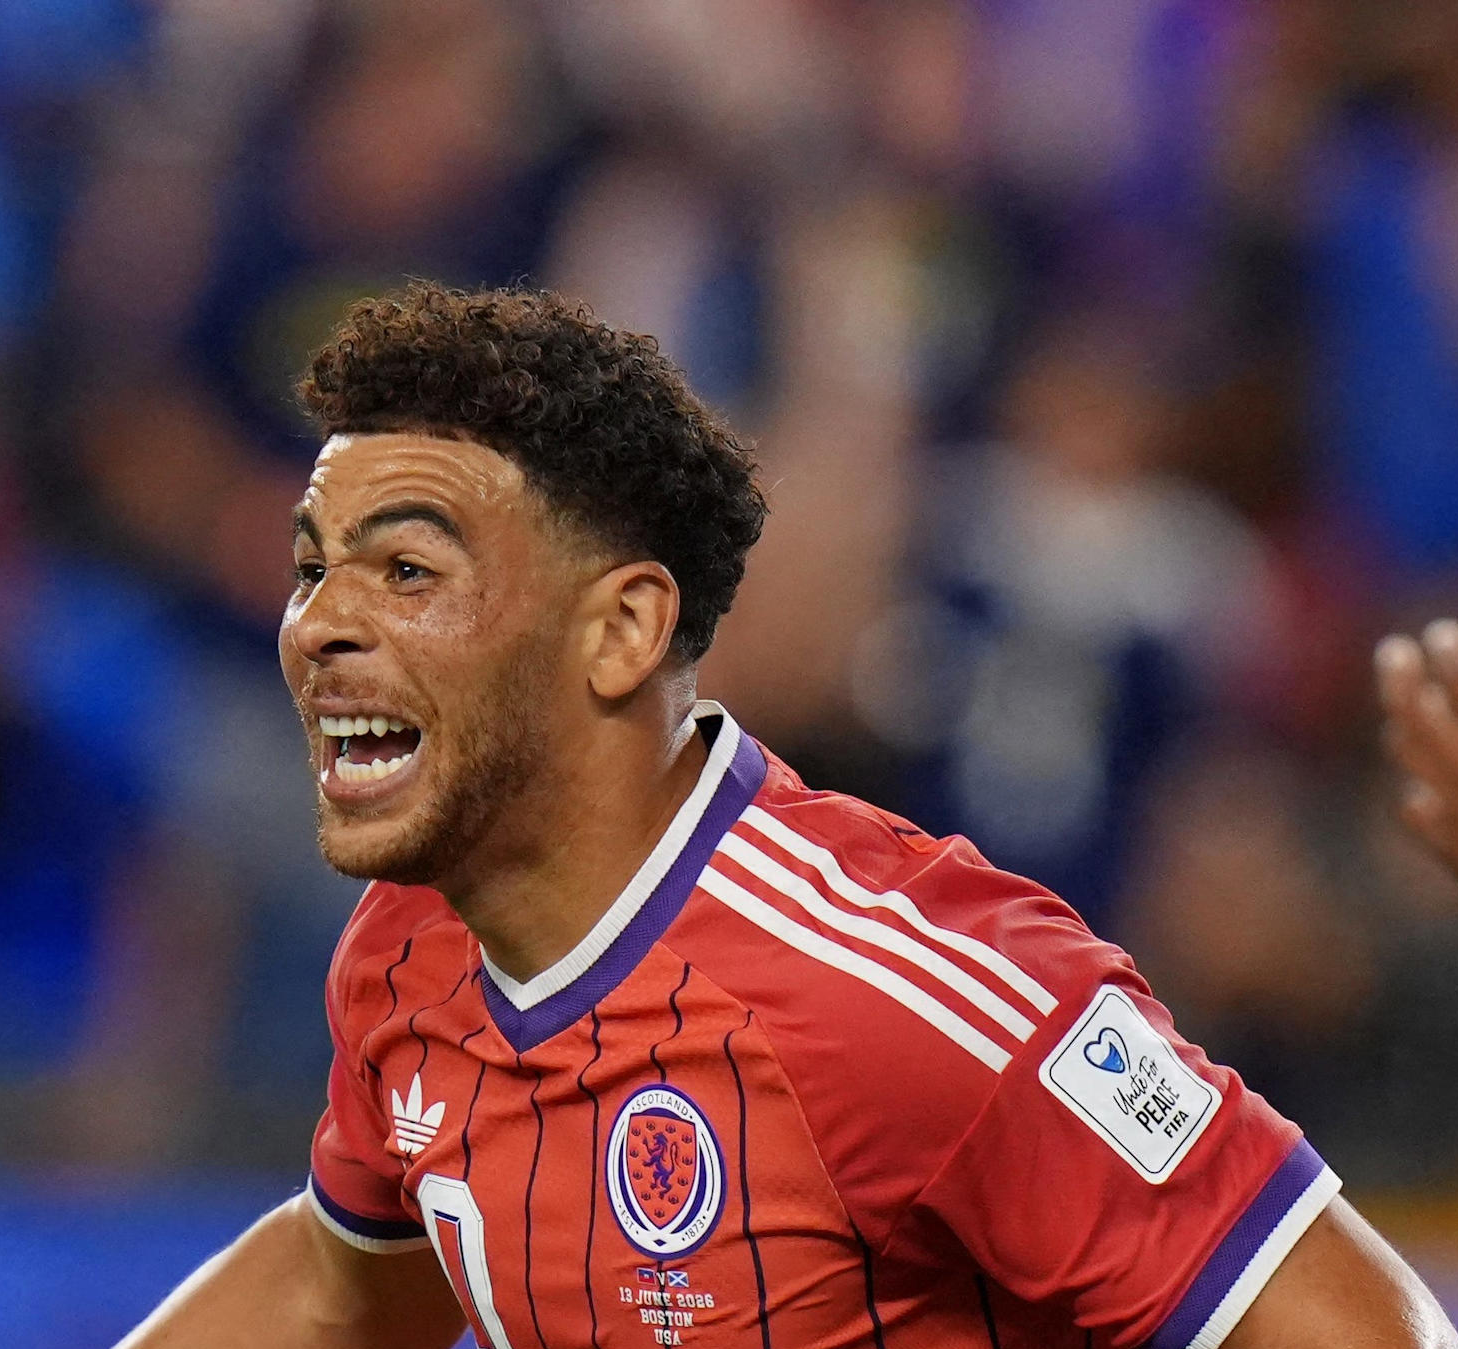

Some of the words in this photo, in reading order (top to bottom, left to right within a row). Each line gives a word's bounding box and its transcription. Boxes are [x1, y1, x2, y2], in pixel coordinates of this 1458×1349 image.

[1112, 1074, 1148, 1115] Unite
[1138, 1055, 1159, 1084] For
[636, 1093, 689, 1116] SCOTLAND
[1135, 1078, 1180, 1134] PEACE
[1164, 1110, 1189, 1138] FIFA
[685, 1219, 705, 1239] 1873
[618, 1286, 633, 1303] 13
[635, 1289, 674, 1307] JUNE
[676, 1293, 715, 1309] 2026
[639, 1308, 694, 1327] BOSTON
[654, 1328, 683, 1346] USA
